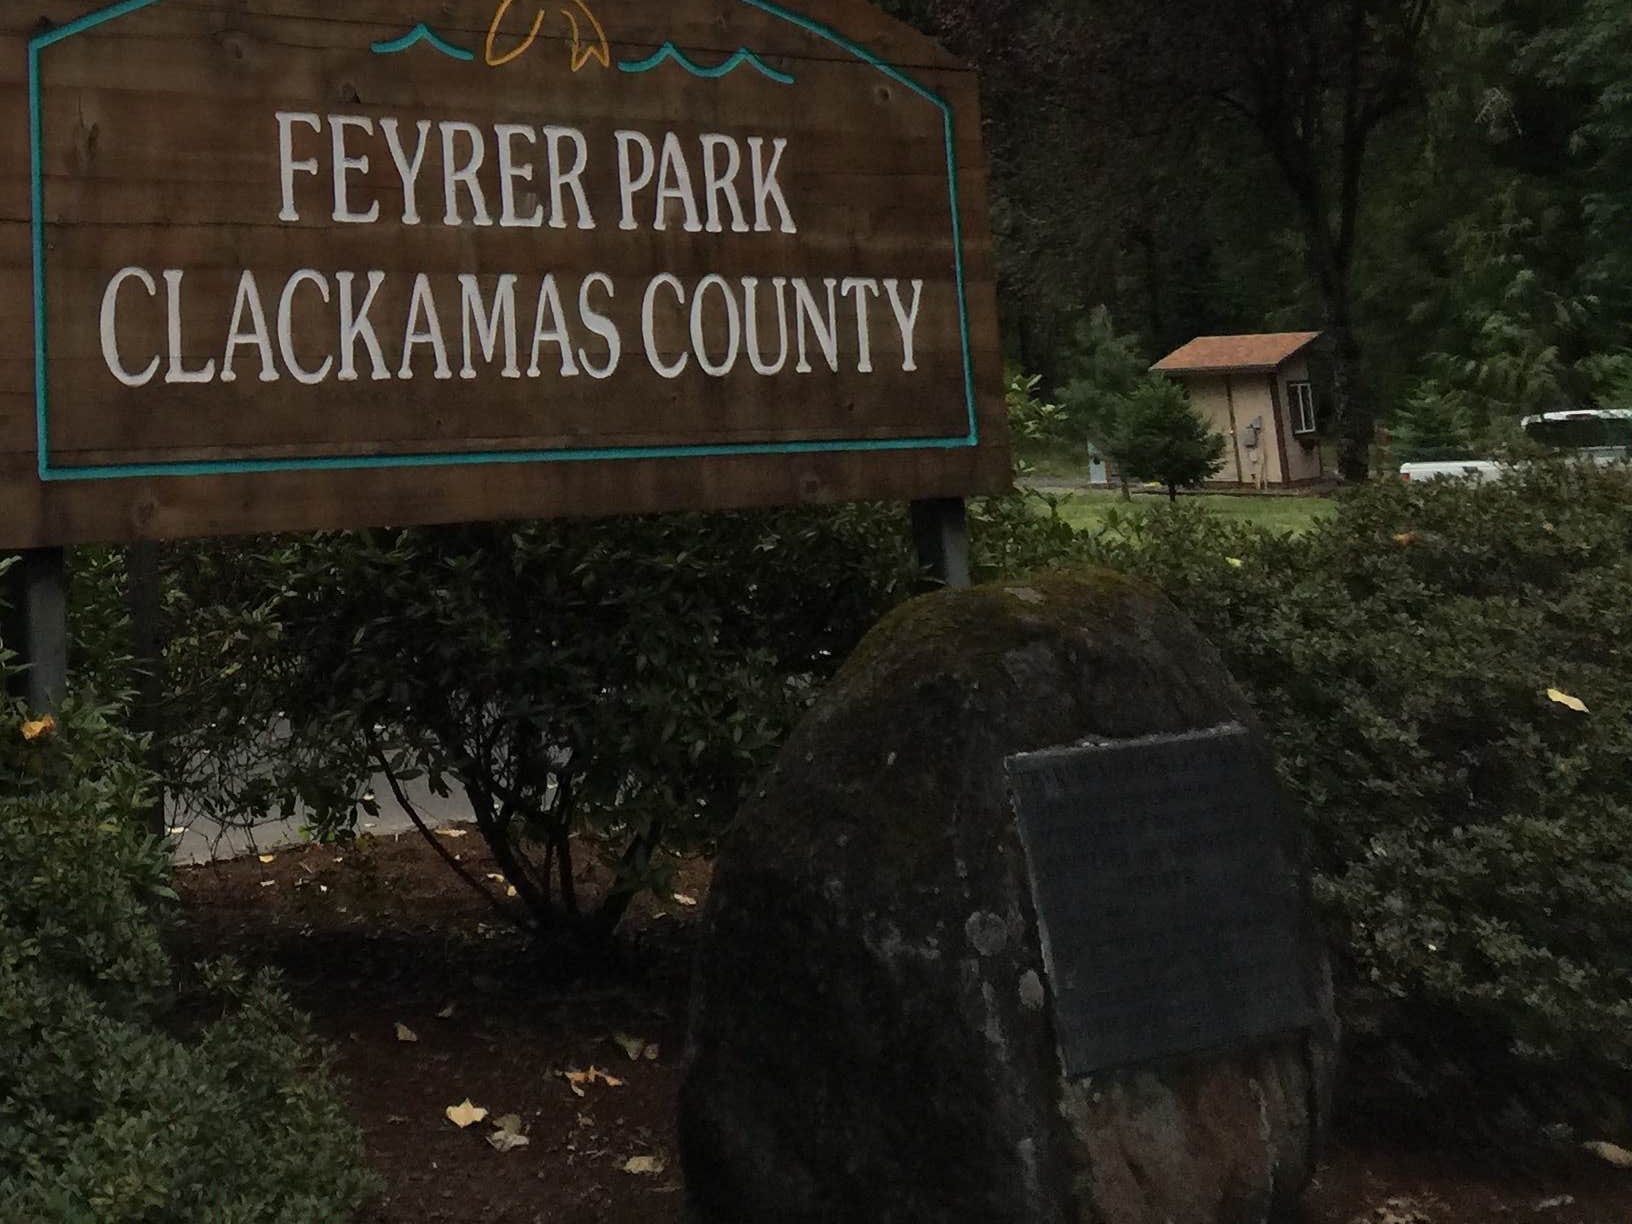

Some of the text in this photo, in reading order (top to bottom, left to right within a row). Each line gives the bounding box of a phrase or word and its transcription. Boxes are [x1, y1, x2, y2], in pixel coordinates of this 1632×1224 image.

[275, 112, 796, 233] FEYRER PARK
[100, 267, 922, 386] CLACKAMAS COUNTY
